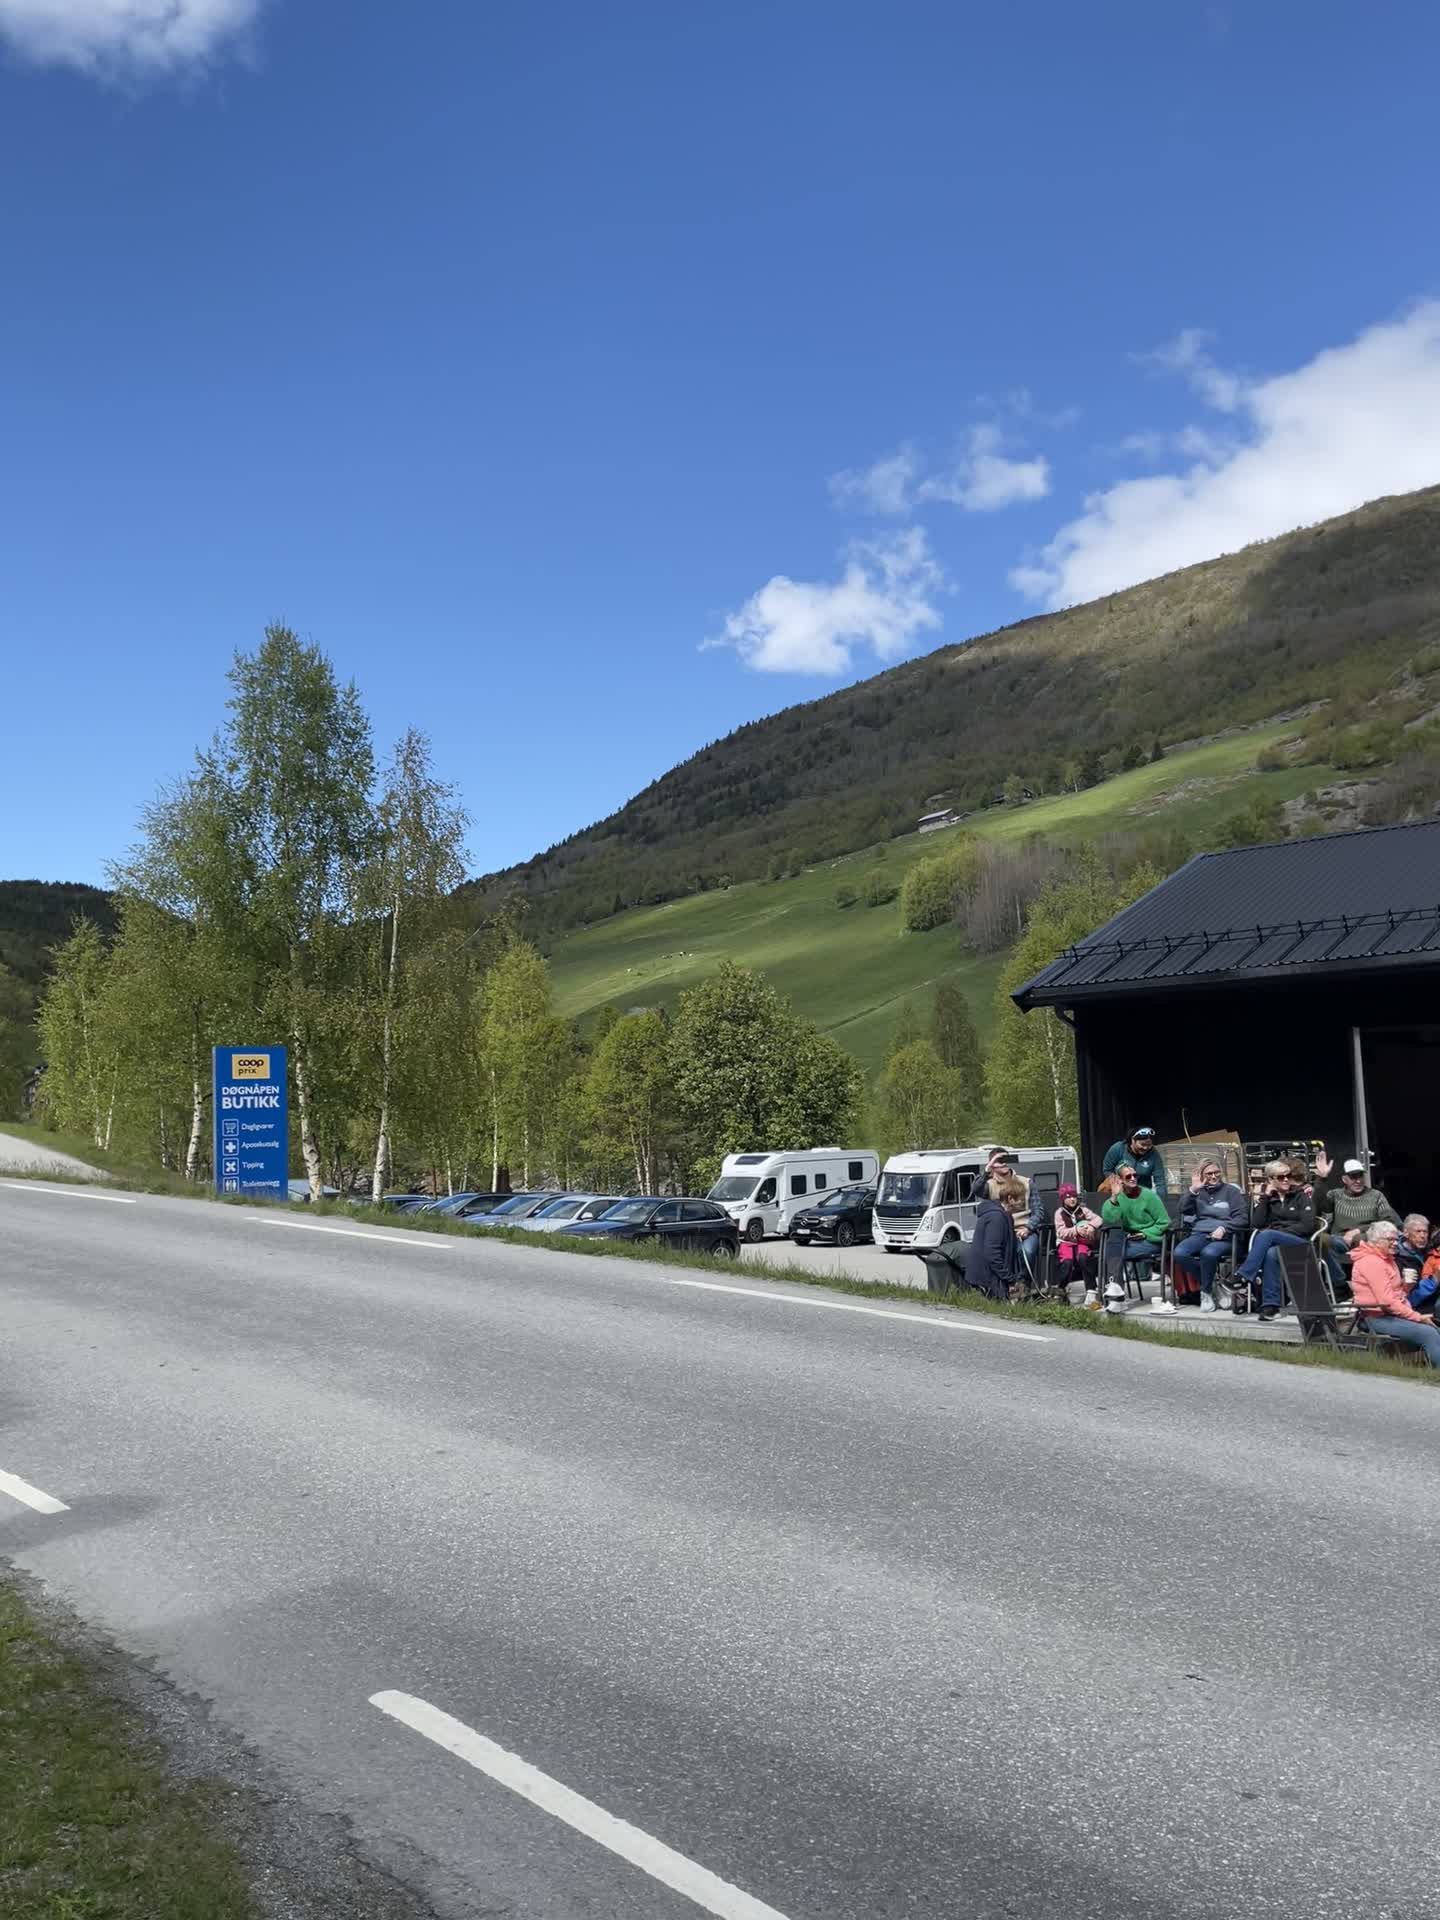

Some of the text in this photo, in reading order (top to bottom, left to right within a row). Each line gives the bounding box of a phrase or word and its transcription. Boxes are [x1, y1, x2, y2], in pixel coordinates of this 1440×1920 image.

[238, 1059, 264, 1067] coop
[238, 1066, 257, 1076] prix
[222, 1083, 280, 1095] DØGNÅPEN
[222, 1095, 280, 1109] BUTIKK
[241, 1161, 265, 1169] Tipping
